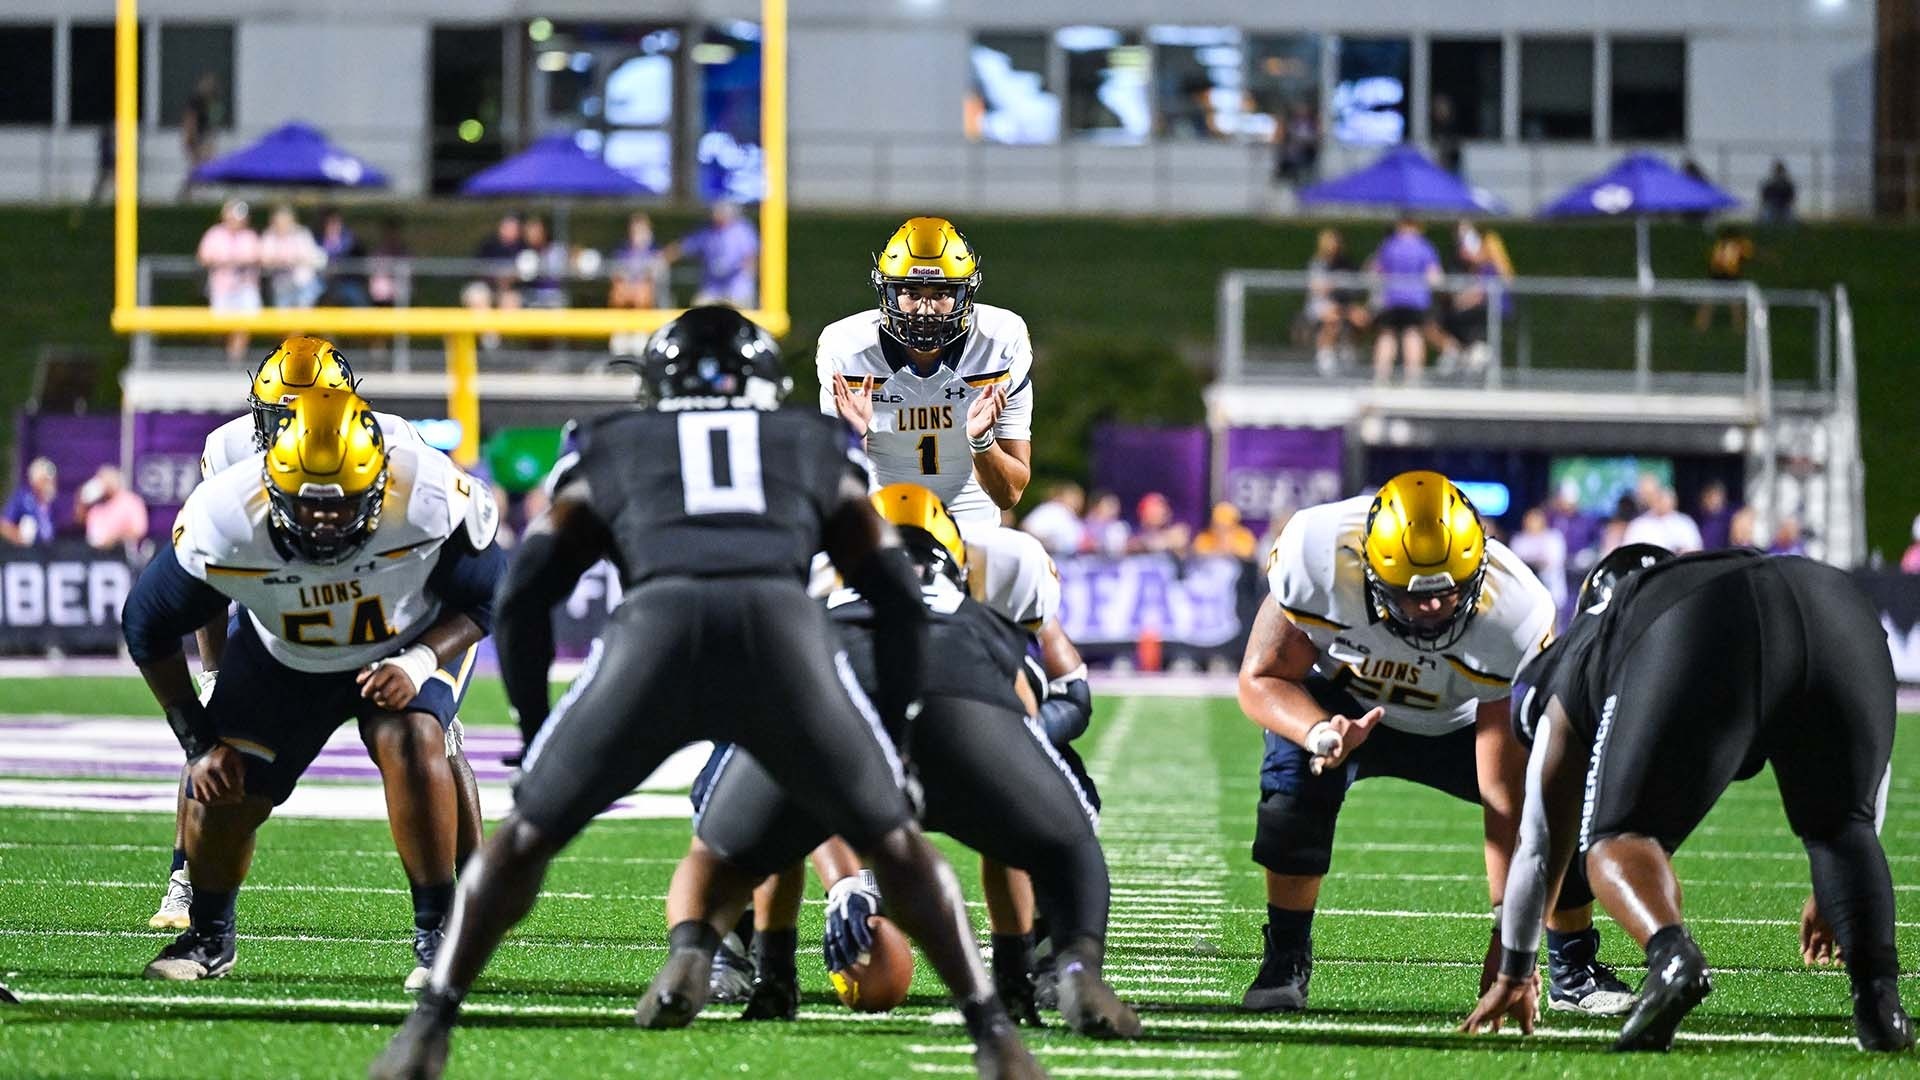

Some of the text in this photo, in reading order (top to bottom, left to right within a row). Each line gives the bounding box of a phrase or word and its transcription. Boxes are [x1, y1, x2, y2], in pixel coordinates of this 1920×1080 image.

[912, 267, 941, 276] Riddell
[898, 405, 953, 432] LIONS
[677, 410, 767, 515] 0
[916, 433, 941, 476] 1
[0, 561, 131, 627] BER
[299, 578, 364, 608] LIONS
[1361, 657, 1422, 685] LIONS
